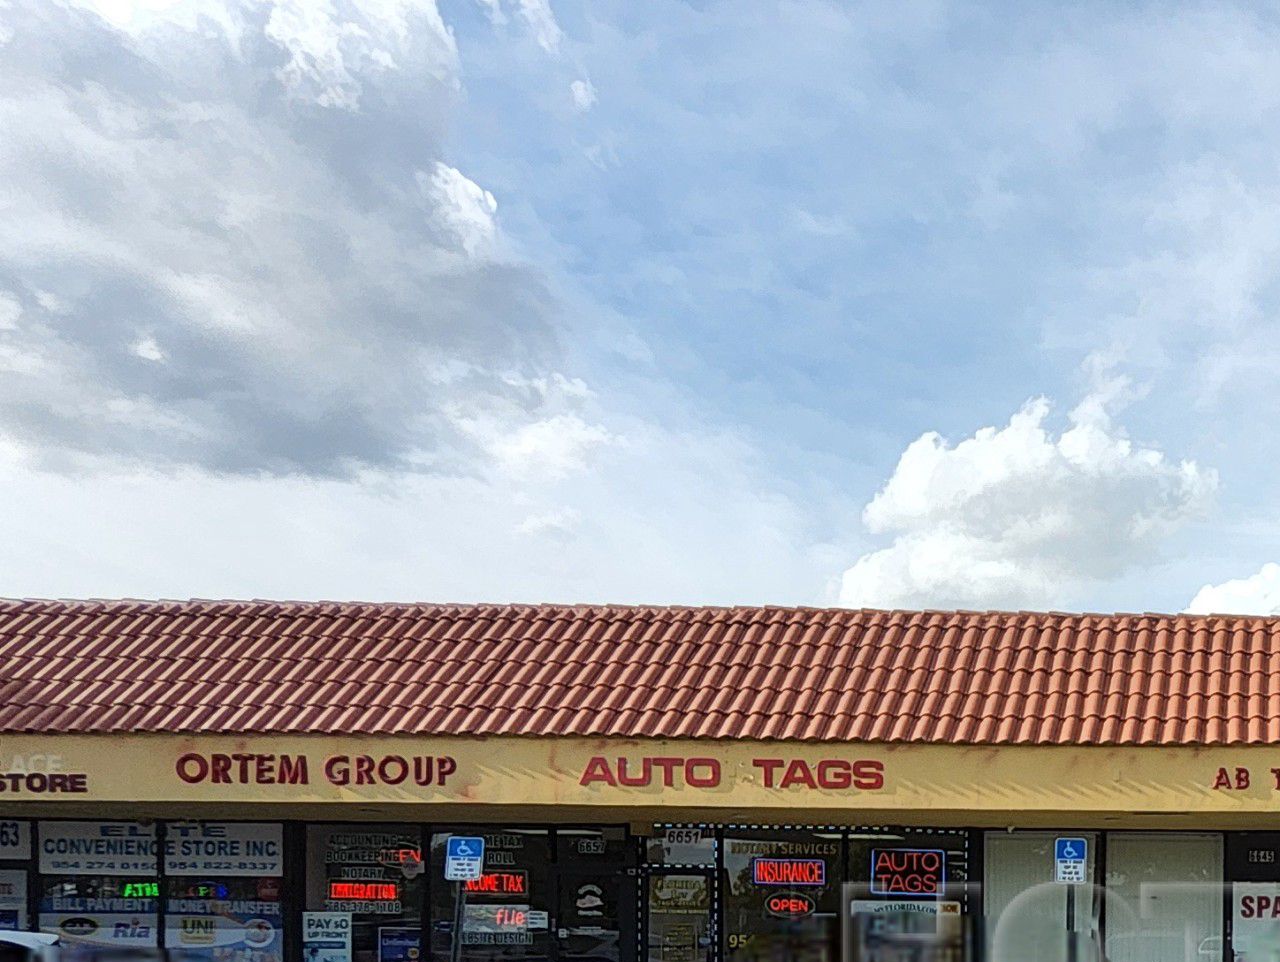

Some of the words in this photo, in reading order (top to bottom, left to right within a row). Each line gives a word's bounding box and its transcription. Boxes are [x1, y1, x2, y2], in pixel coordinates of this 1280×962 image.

[175, 753, 309, 784] ORTEM
[325, 755, 457, 785] GROUP
[579, 757, 721, 787] AUTO
[752, 759, 884, 789] TAGS
[1213, 768, 1250, 789] AB
[100, 825, 227, 837] ELTE
[668, 830, 699, 843] 6651
[43, 838, 176, 855] CONVENIENCE
[181, 839, 240, 856] STORE
[329, 834, 397, 846] ACCOUNTING
[781, 843, 837, 855] SERVICES
[326, 850, 400, 863] BOOKKEEPING
[875, 852, 939, 871] AUTO
[168, 862, 198, 870] 954
[756, 861, 823, 883] INSURANCE
[341, 868, 384, 879] NOTARY
[465, 873, 500, 892] NCOME
[503, 874, 524, 892] TAX
[877, 874, 938, 892] TAGS
[53, 899, 85, 911] BILL
[87, 899, 150, 912] PAYMENT
[168, 900, 211, 912] MONEY
[769, 898, 809, 912] OPEN
[113, 917, 150, 938] Ria
[307, 919, 332, 930] PAY
